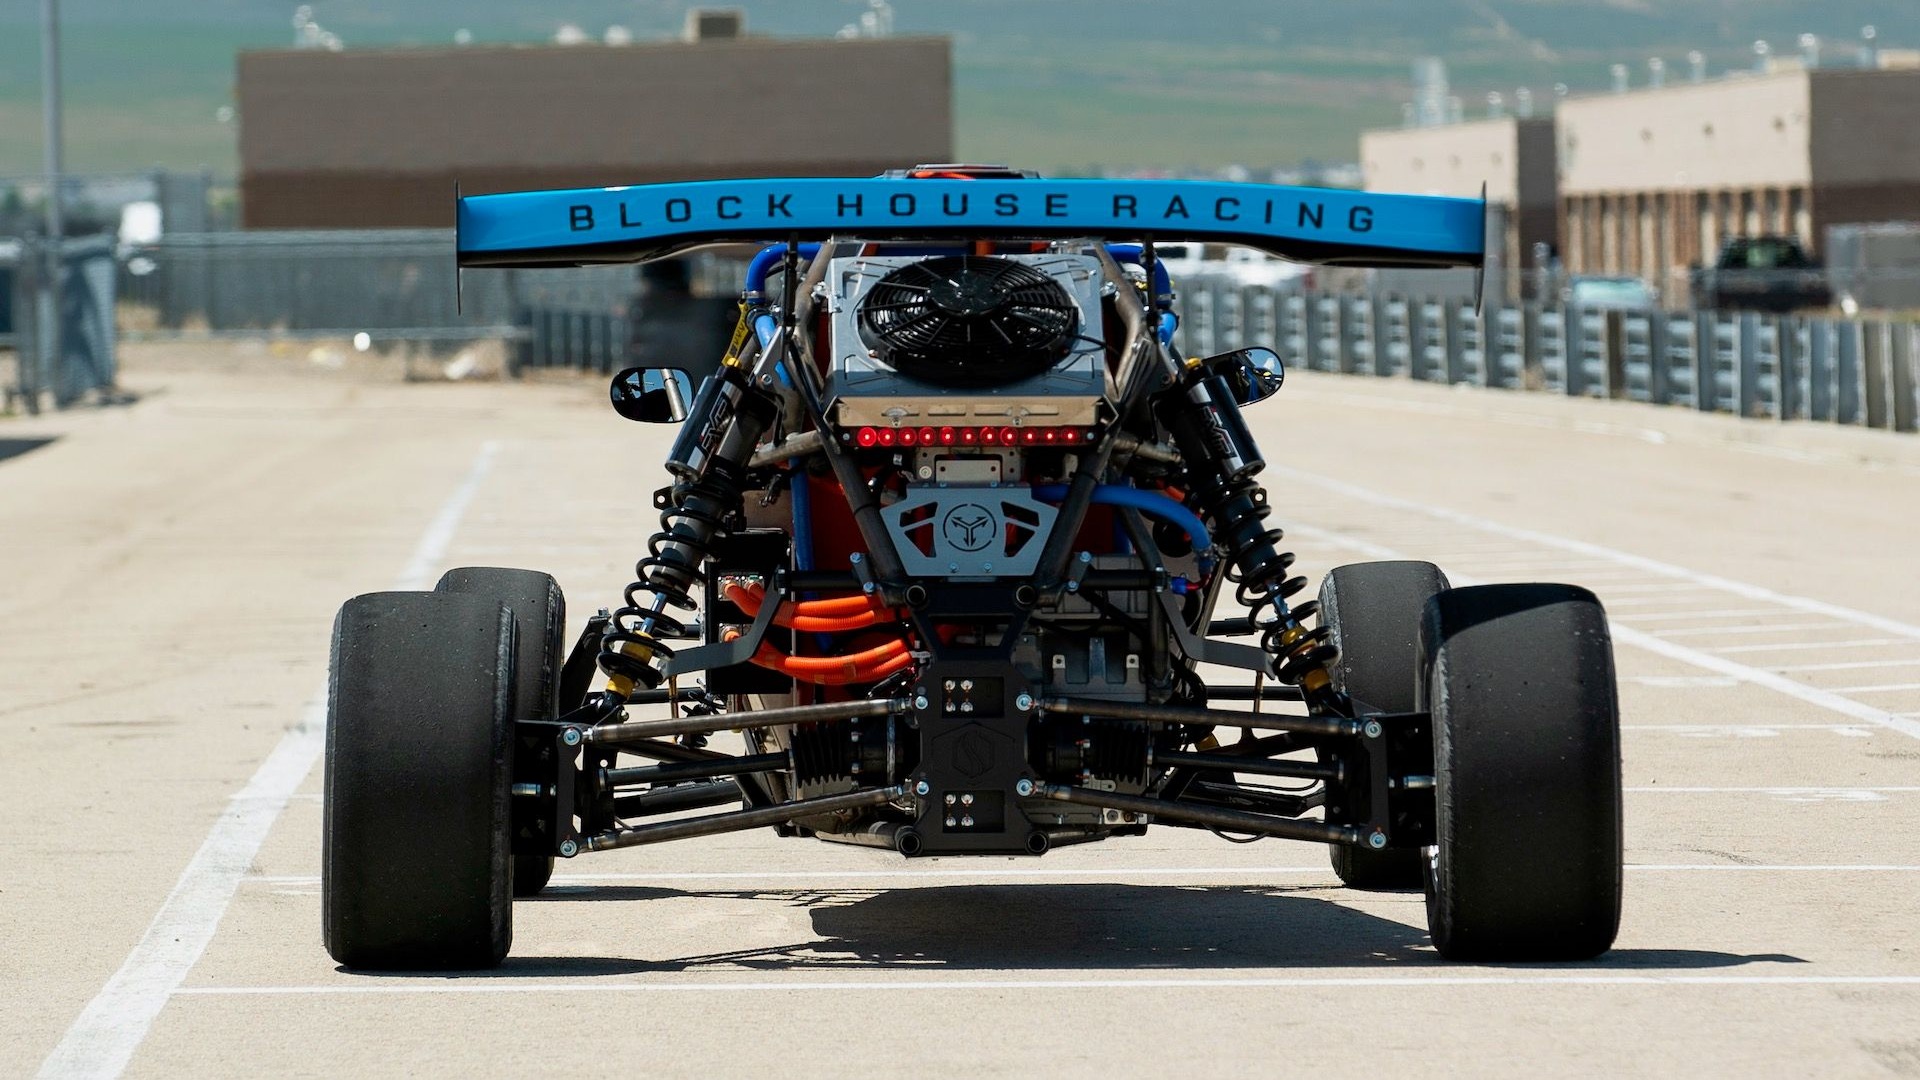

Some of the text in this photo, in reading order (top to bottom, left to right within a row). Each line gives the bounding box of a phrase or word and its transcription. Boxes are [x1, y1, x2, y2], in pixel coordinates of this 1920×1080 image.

[569, 193, 1374, 233] BLOCK HOUSE RACING
